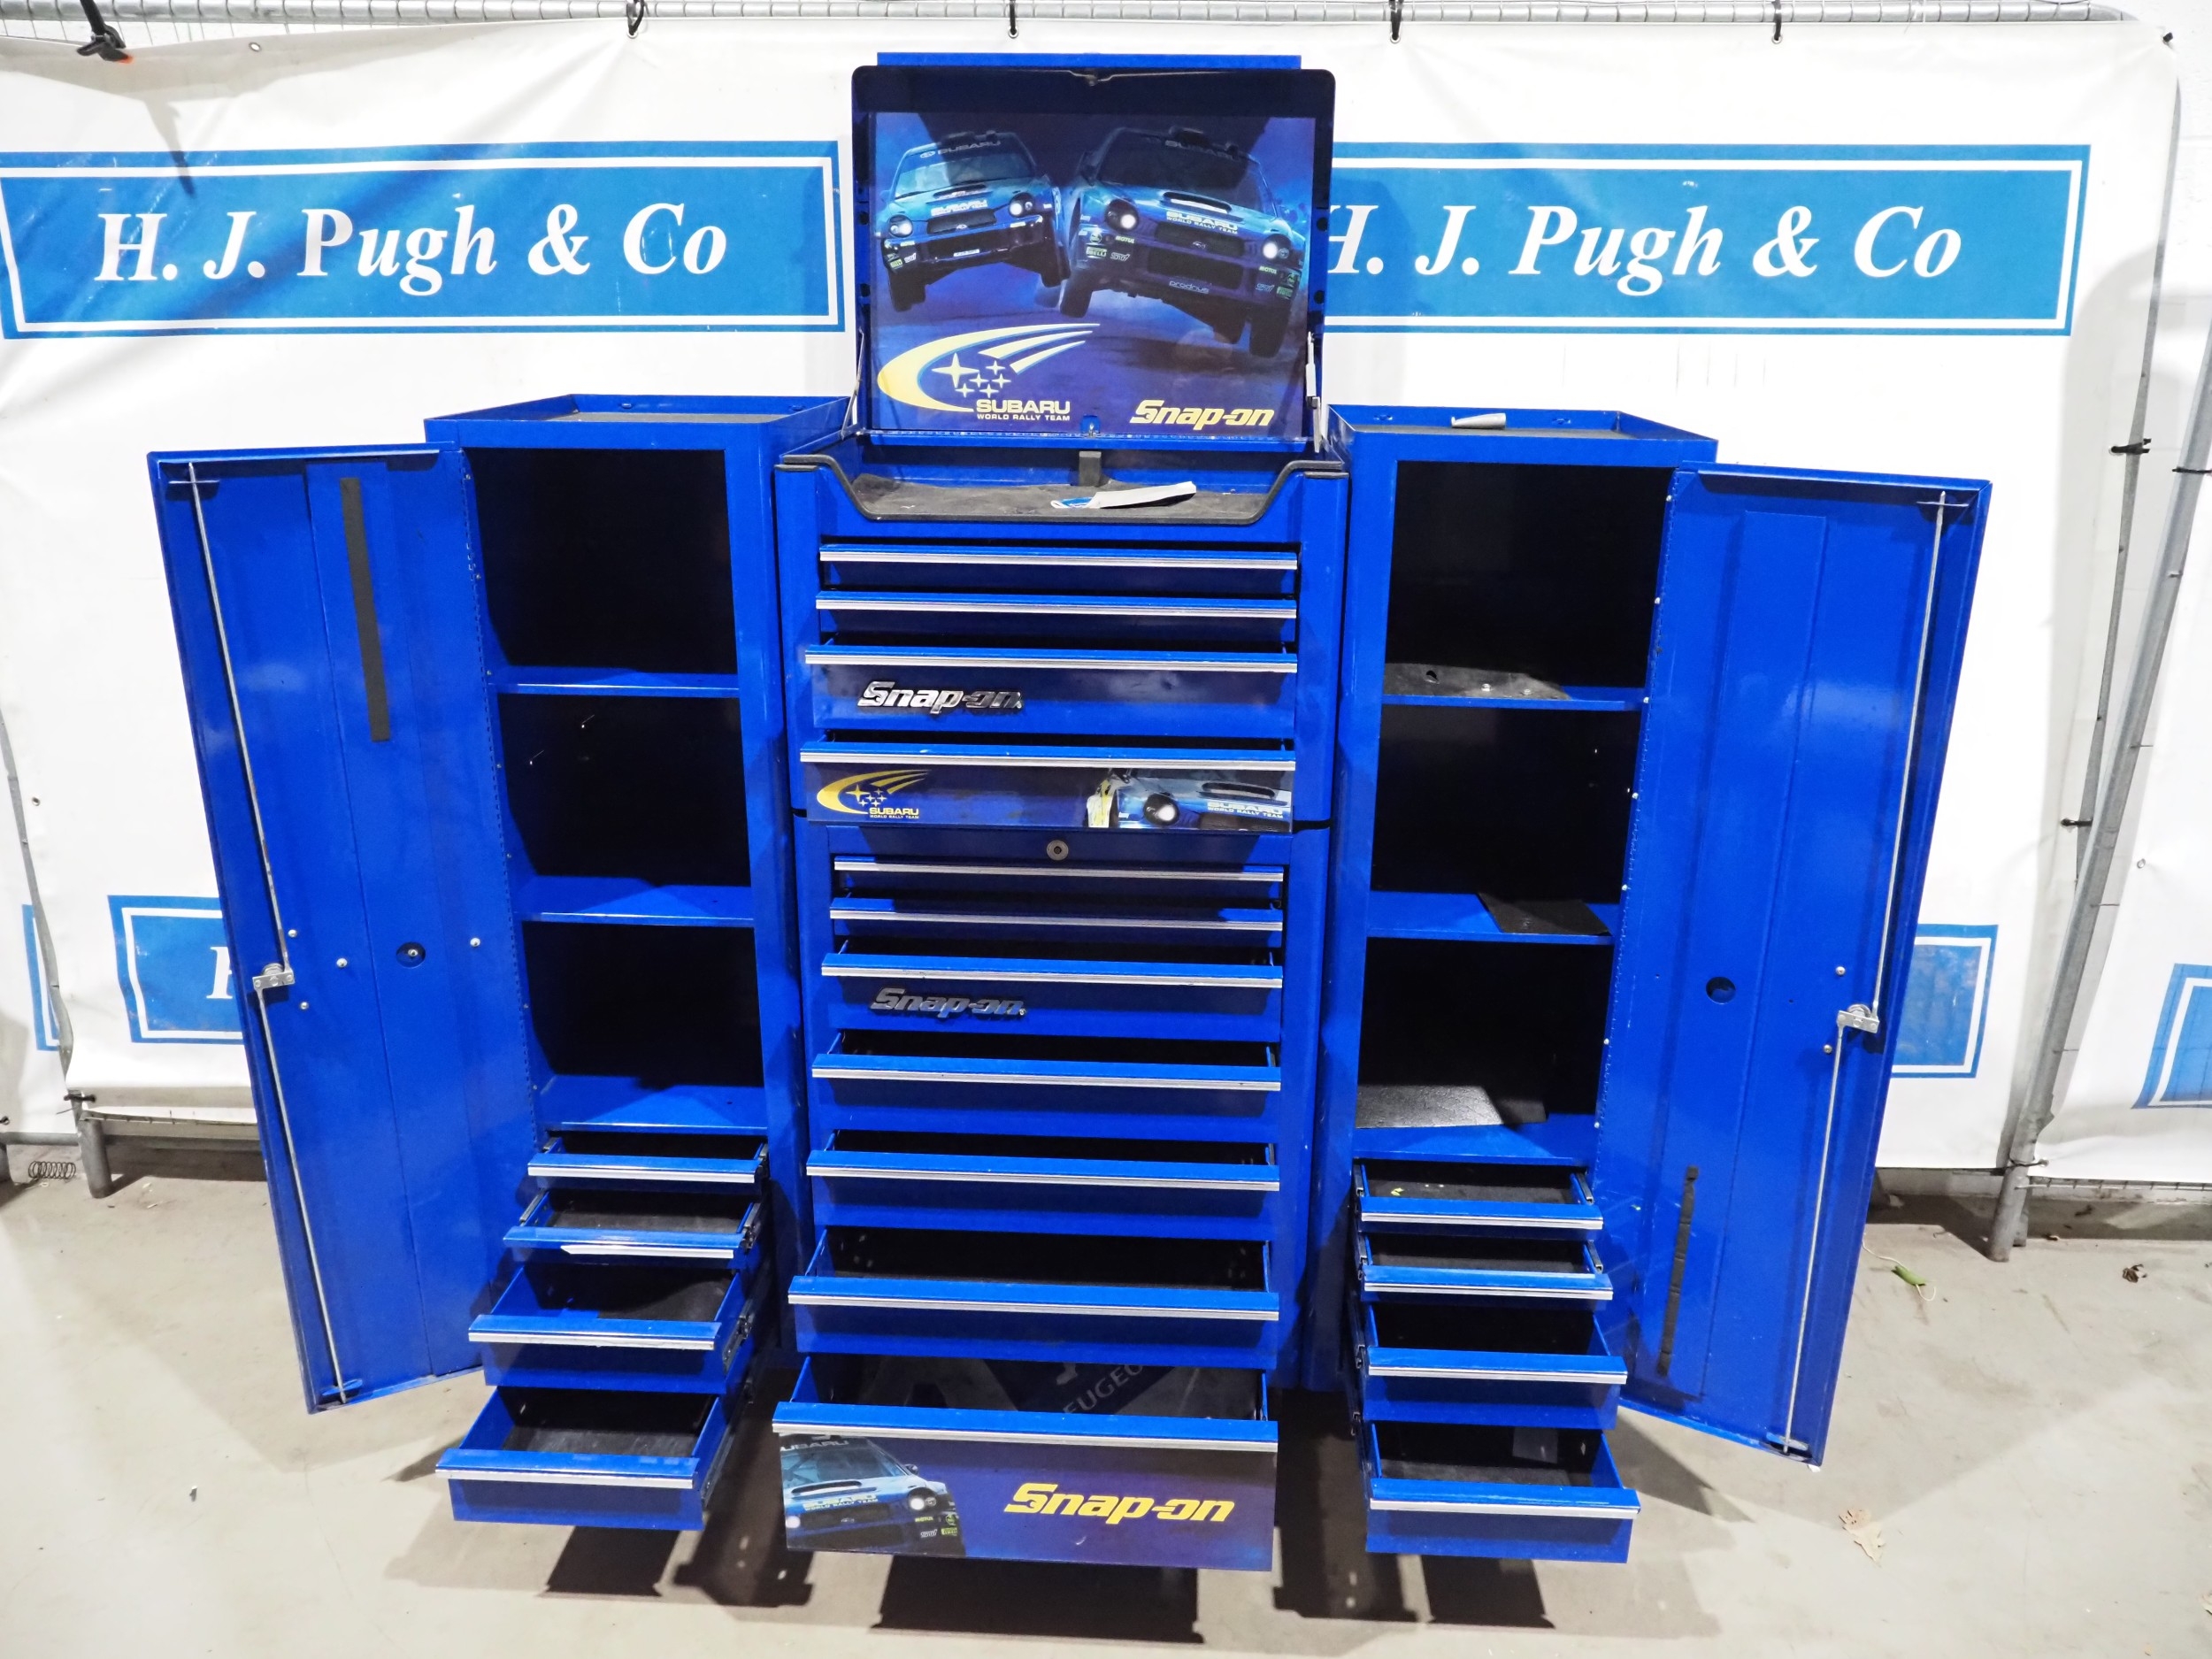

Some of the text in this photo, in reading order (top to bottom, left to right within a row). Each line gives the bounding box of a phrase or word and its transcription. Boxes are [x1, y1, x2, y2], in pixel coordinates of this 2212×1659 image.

[1166, 211, 1238, 231] SUBARU
[1167, 216, 1192, 225] WORLD
[95, 204, 726, 296] H. J. Pugh & Co
[1415, 205, 1479, 275] J.
[1509, 205, 1723, 296] Pugh
[1753, 205, 1819, 278] &
[1855, 206, 1961, 278] Co
[976, 399, 1071, 415] SUBARU
[1129, 400, 1275, 430] Snap-on
[857, 680, 1022, 715] Snap-on
[869, 807, 919, 816] SUBARU
[870, 987, 1025, 1018] Snap-on
[780, 1440, 849, 1453] UBARU
[1003, 1482, 1235, 1525] Snap-on
